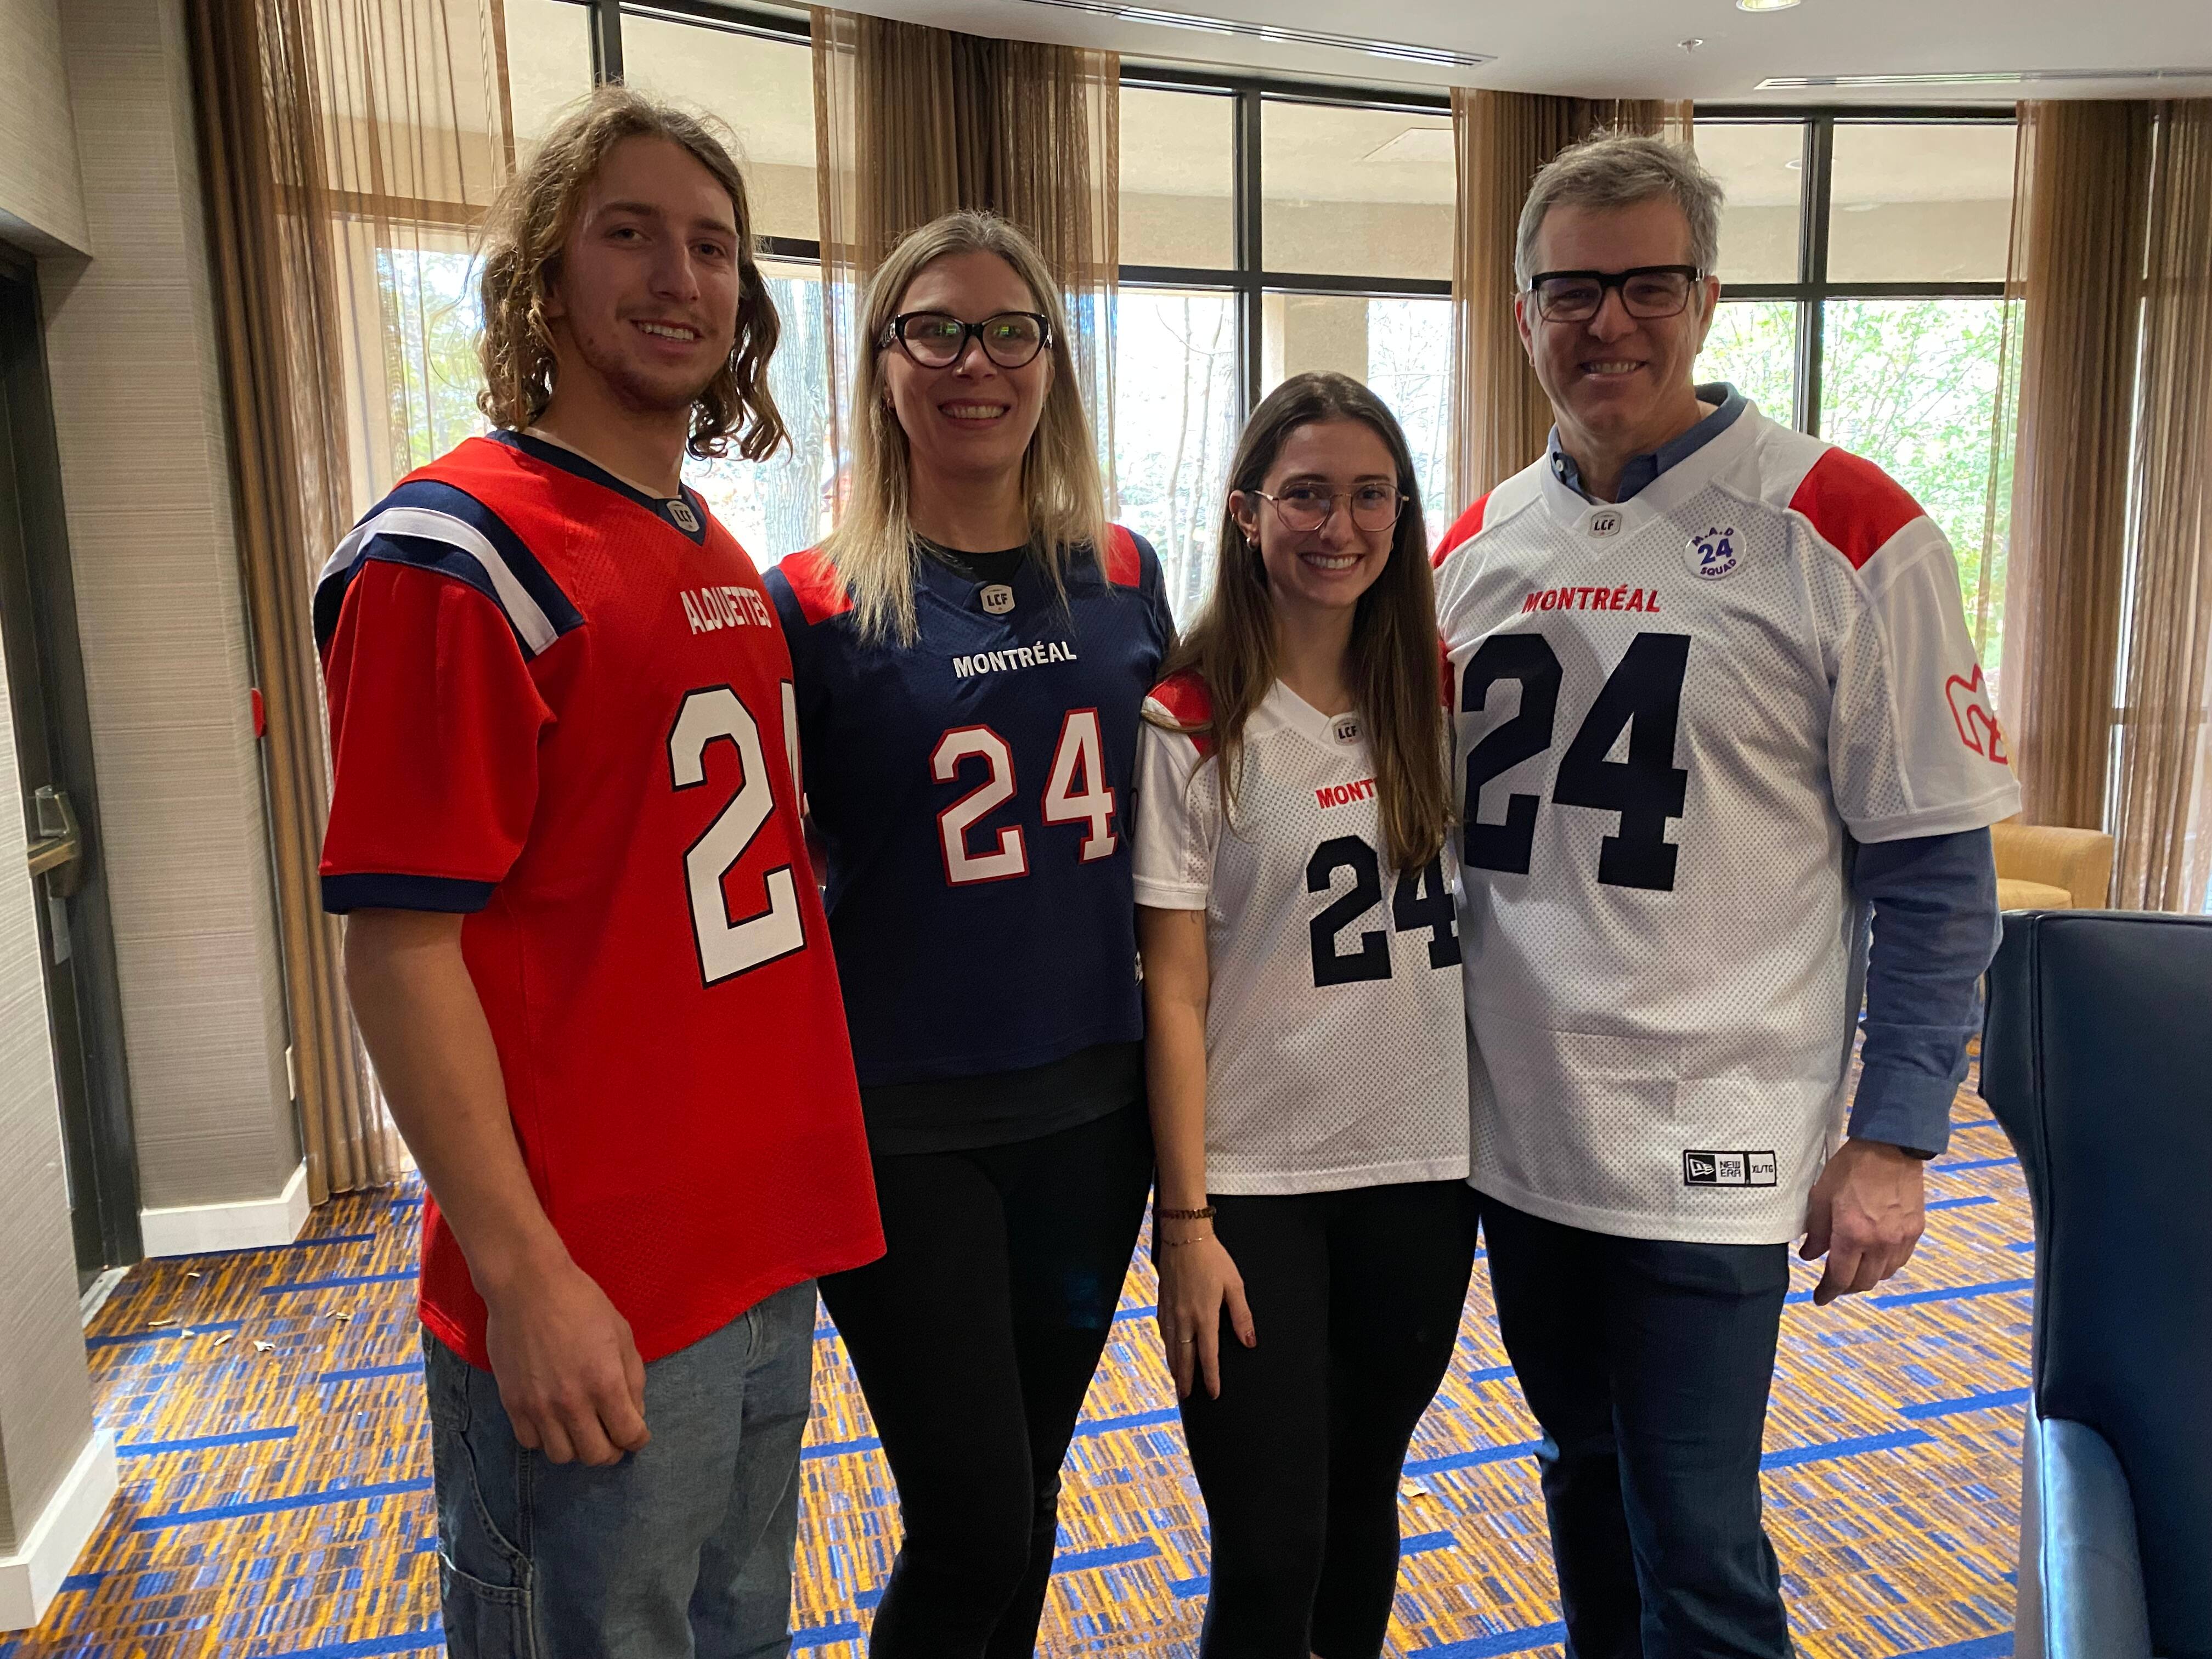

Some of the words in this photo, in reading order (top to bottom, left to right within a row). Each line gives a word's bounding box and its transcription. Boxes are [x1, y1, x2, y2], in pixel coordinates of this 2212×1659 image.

[675, 509, 693, 523] LCF
[1594, 519, 1615, 531] LCF
[1697, 538, 1733, 566] 24
[1700, 558, 1736, 576] SQUAD
[680, 586, 772, 635] ALOUETTES
[986, 593, 1008, 606] LCF
[1521, 584, 1660, 614] MONTRÉAL
[953, 641, 1077, 678] MONTRÉAL
[1338, 725, 1357, 739] LCF
[1462, 632, 1692, 892] 24
[928, 707, 1118, 888] 24
[1316, 778, 1376, 809] MONT
[665, 678, 808, 990] 2
[1306, 835, 1463, 988] 24
[1720, 1169, 1741, 1177] ERA
[1752, 1165, 1774, 1173] XL/TG
